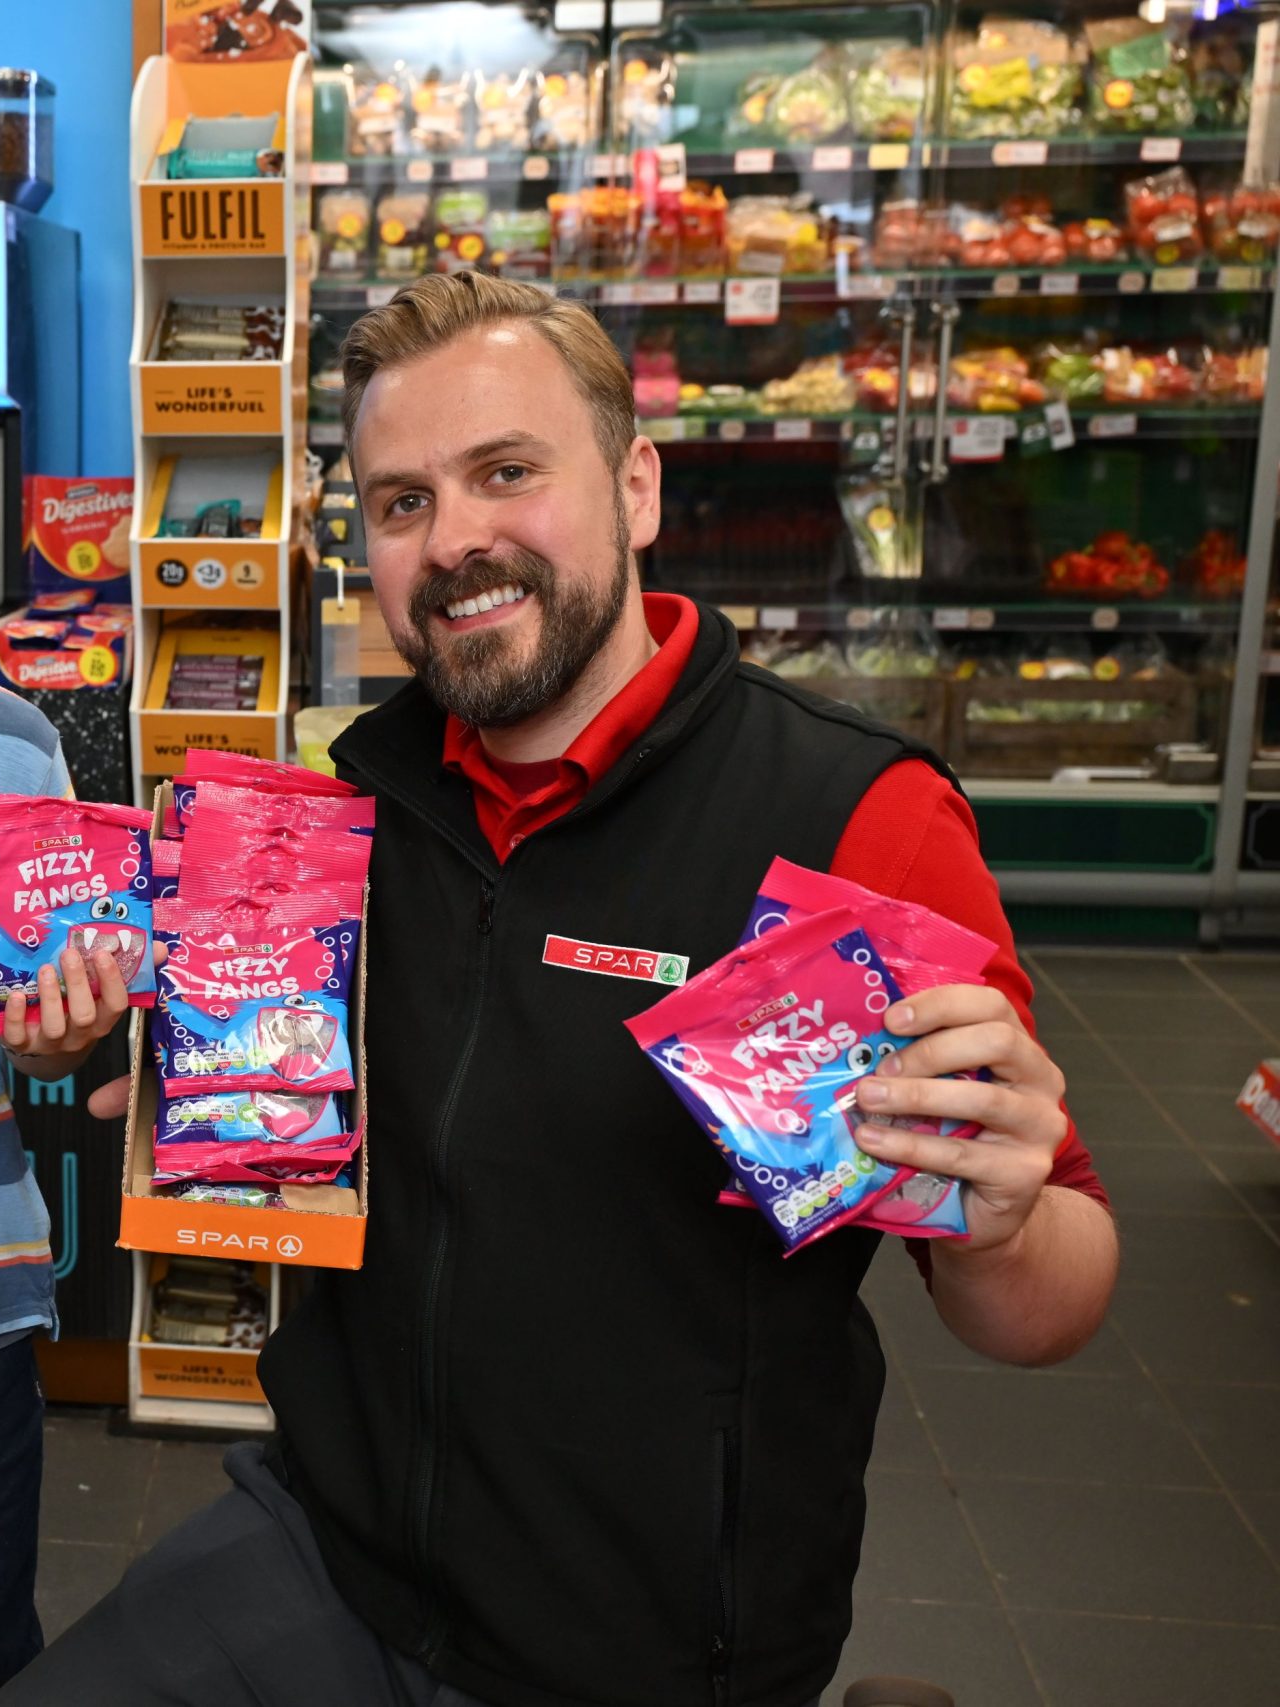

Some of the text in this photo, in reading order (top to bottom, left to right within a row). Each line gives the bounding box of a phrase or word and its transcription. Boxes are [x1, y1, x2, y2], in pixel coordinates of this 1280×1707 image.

[160, 189, 265, 241] FULFIL
[187, 387, 232, 399] LIFE'S
[155, 401, 265, 413] WONDERFUEL
[41, 837, 70, 849] SPAR
[18, 848, 95, 885] FIZZY
[13, 874, 108, 913] FANGS
[208, 957, 288, 979] FIZZY
[573, 948, 654, 975] SPAR
[205, 977, 300, 1001] FANGS
[749, 1000, 783, 1022] SPAR
[731, 1000, 824, 1070] FIZZY
[745, 1021, 857, 1101] FANGS
[176, 1229, 269, 1251] SPAR
[154, 1374, 254, 1388] WONDERFUEL
